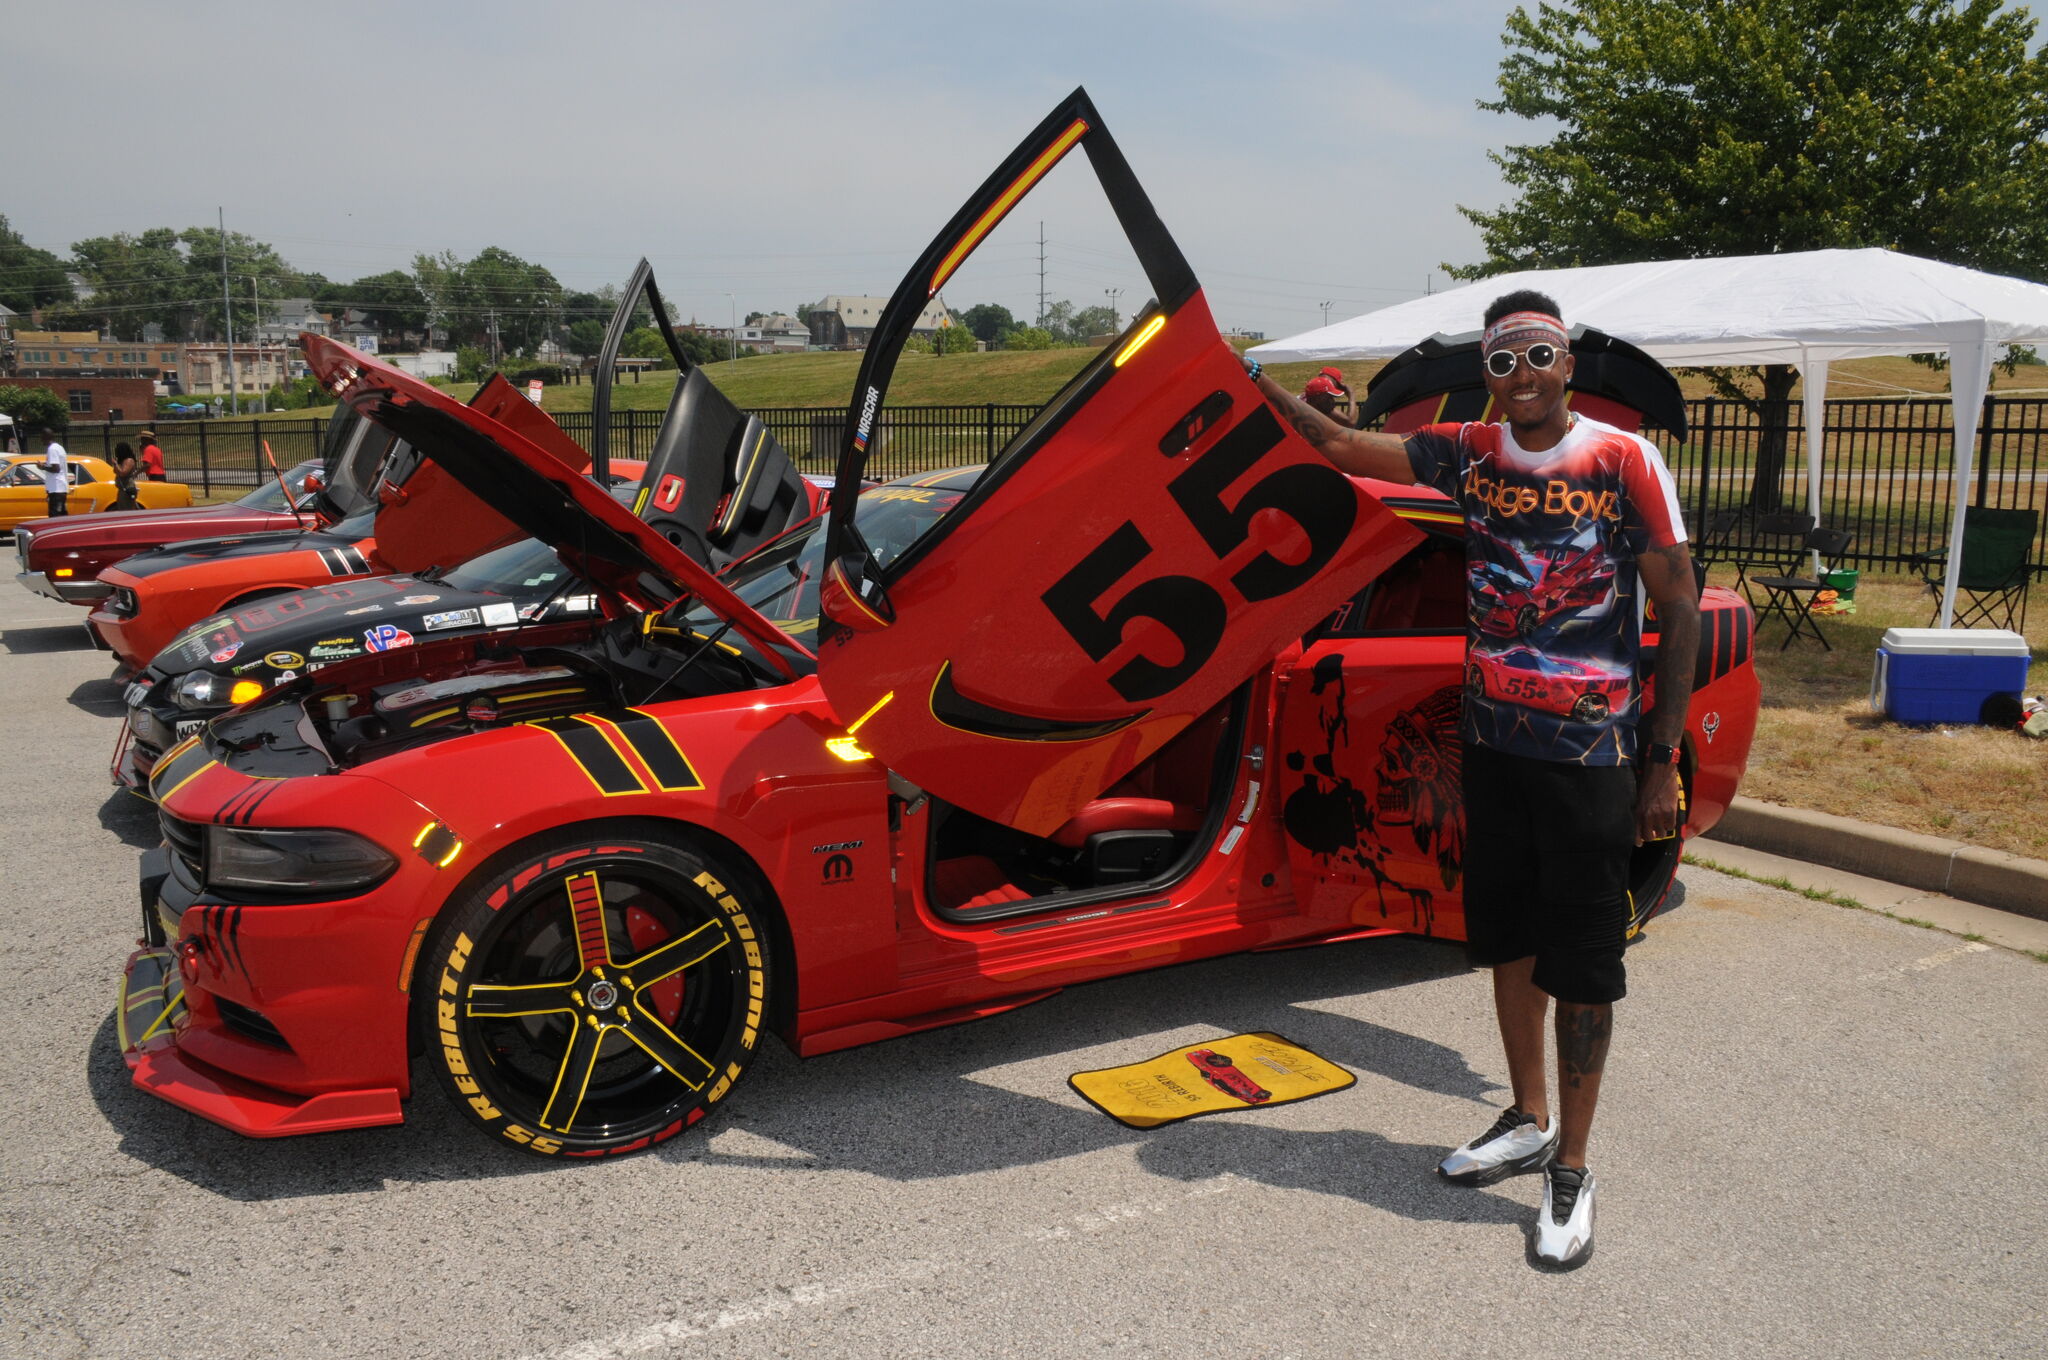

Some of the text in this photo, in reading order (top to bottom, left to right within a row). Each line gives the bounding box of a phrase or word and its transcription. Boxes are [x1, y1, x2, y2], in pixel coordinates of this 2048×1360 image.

[857, 385, 880, 437] NASCAR
[1465, 464, 1621, 521] Dodge Boyz
[1040, 402, 1358, 703] 55
[363, 624, 398, 653] VP
[1504, 677, 1538, 699] 55
[811, 840, 864, 855] HEMI
[692, 871, 766, 1051] REDBONE
[437, 931, 565, 1156] 55 REBIRTH
